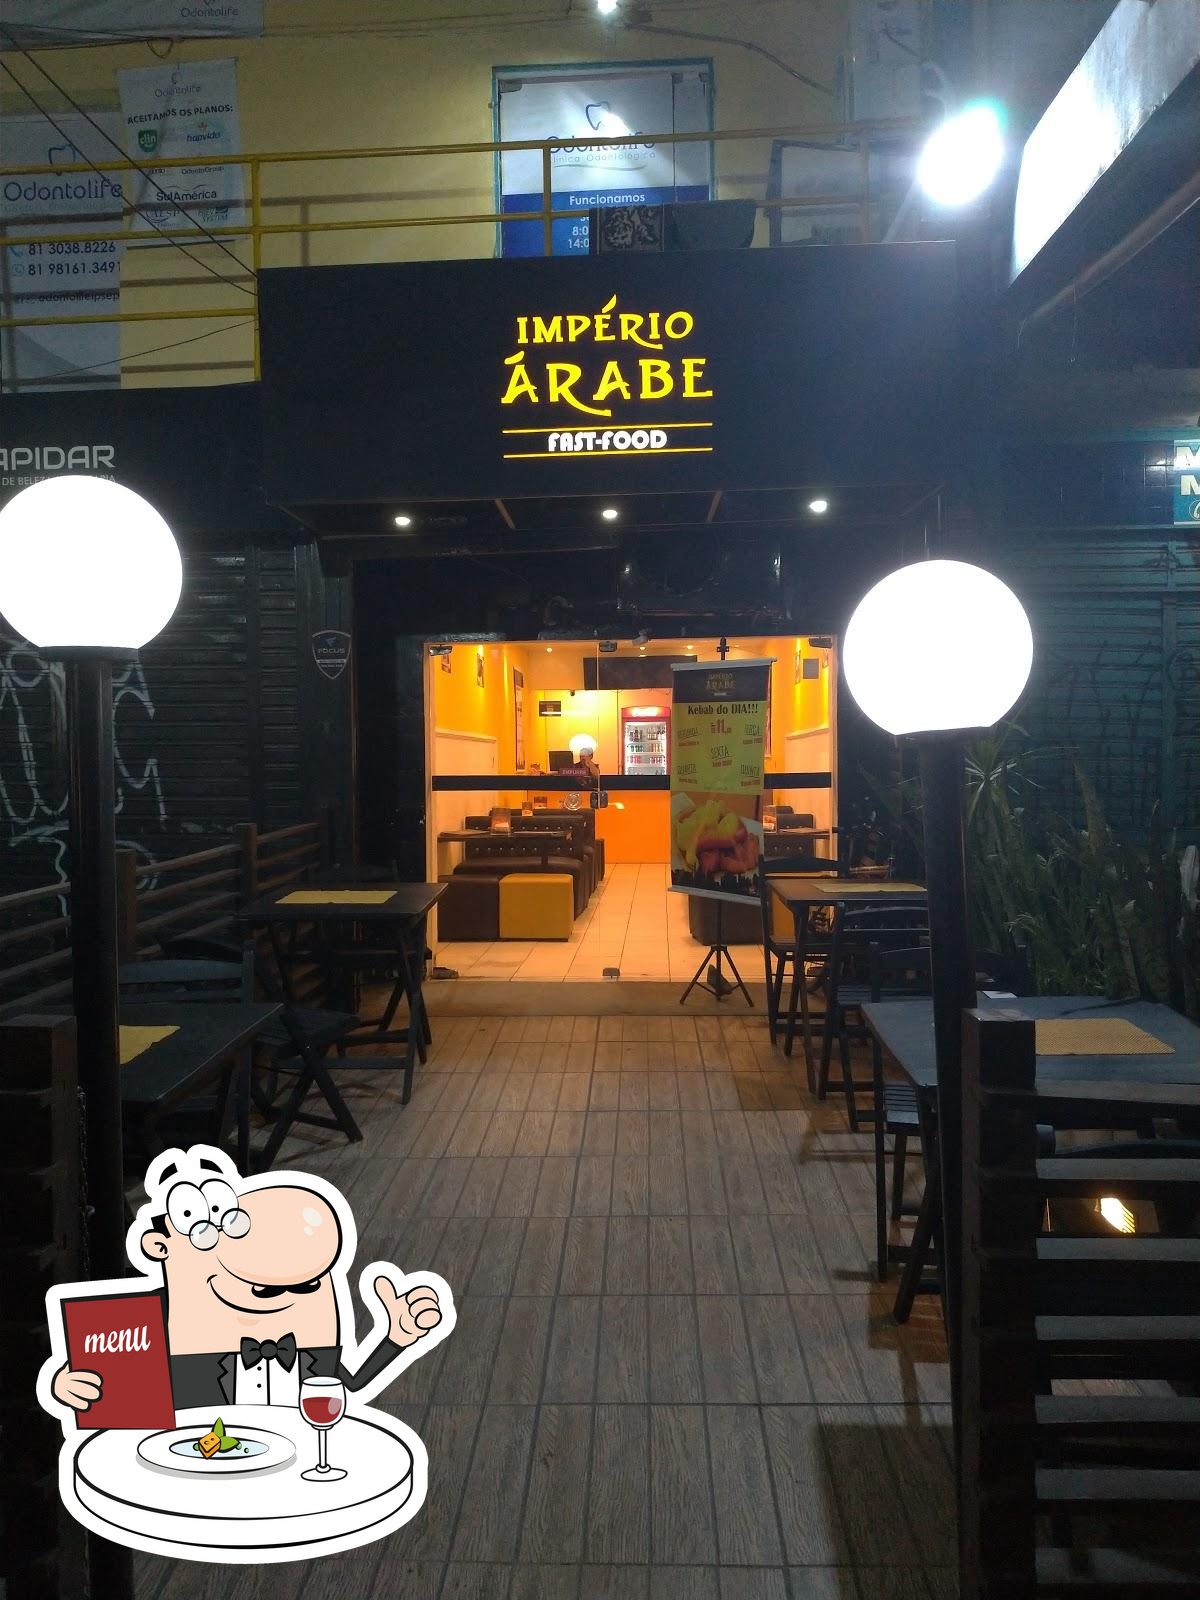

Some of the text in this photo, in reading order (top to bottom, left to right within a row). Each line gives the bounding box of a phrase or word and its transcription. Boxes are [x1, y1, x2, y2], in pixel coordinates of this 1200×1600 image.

[127, 104, 234, 125] ACEITAMOS OS PLANOS:
[4, 178, 122, 202] Odontolife
[569, 194, 645, 206] Funcionamos
[28, 241, 116, 255] 81 3038.8226
[28, 263, 42, 276] 81
[516, 294, 694, 350] IMPÉRIO
[501, 351, 713, 417] ÁRABE
[548, 429, 667, 452] FAST-FOOD
[2, 476, 15, 486] DE
[688, 703, 758, 715] Kebab do DIA!!!
